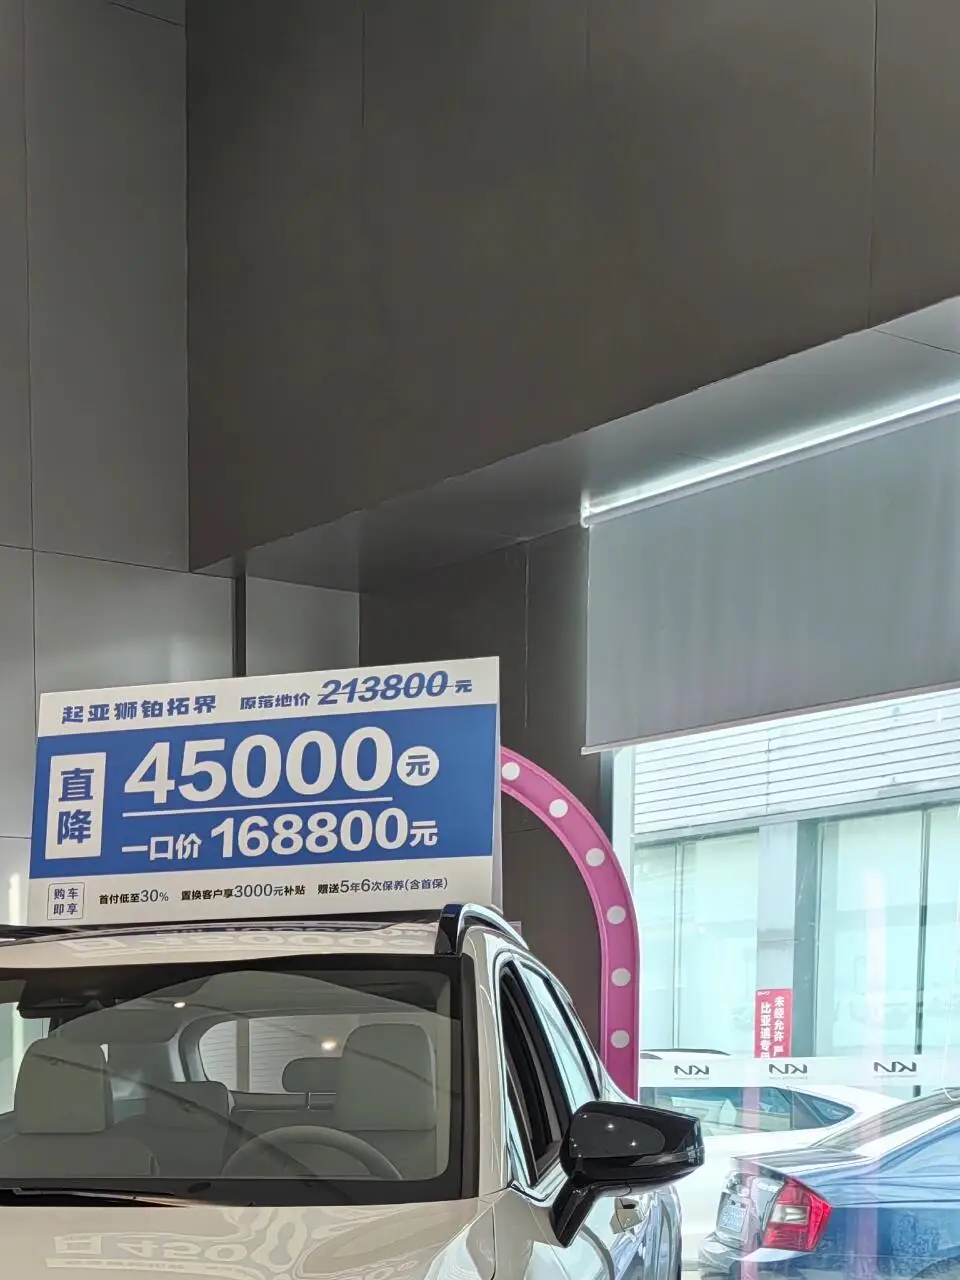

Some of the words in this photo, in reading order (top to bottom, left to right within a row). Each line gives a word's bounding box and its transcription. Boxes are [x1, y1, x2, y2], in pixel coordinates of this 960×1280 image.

[61, 694, 217, 725] 起亚狮铂拓界
[240, 692, 311, 711] 原落地价
[317, 670, 473, 706] 213800元
[56, 767, 95, 846] 直降
[121, 832, 203, 861] 一口价
[210, 807, 439, 859] 168800元
[52, 902, 78, 916] 即享
[53, 887, 79, 900] 购车
[98, 888, 170, 905] 首付低至30%
[180, 883, 307, 901] 置换客户享3000元补贴
[317, 877, 449, 895] 赠送5年6次保养(含首保)
